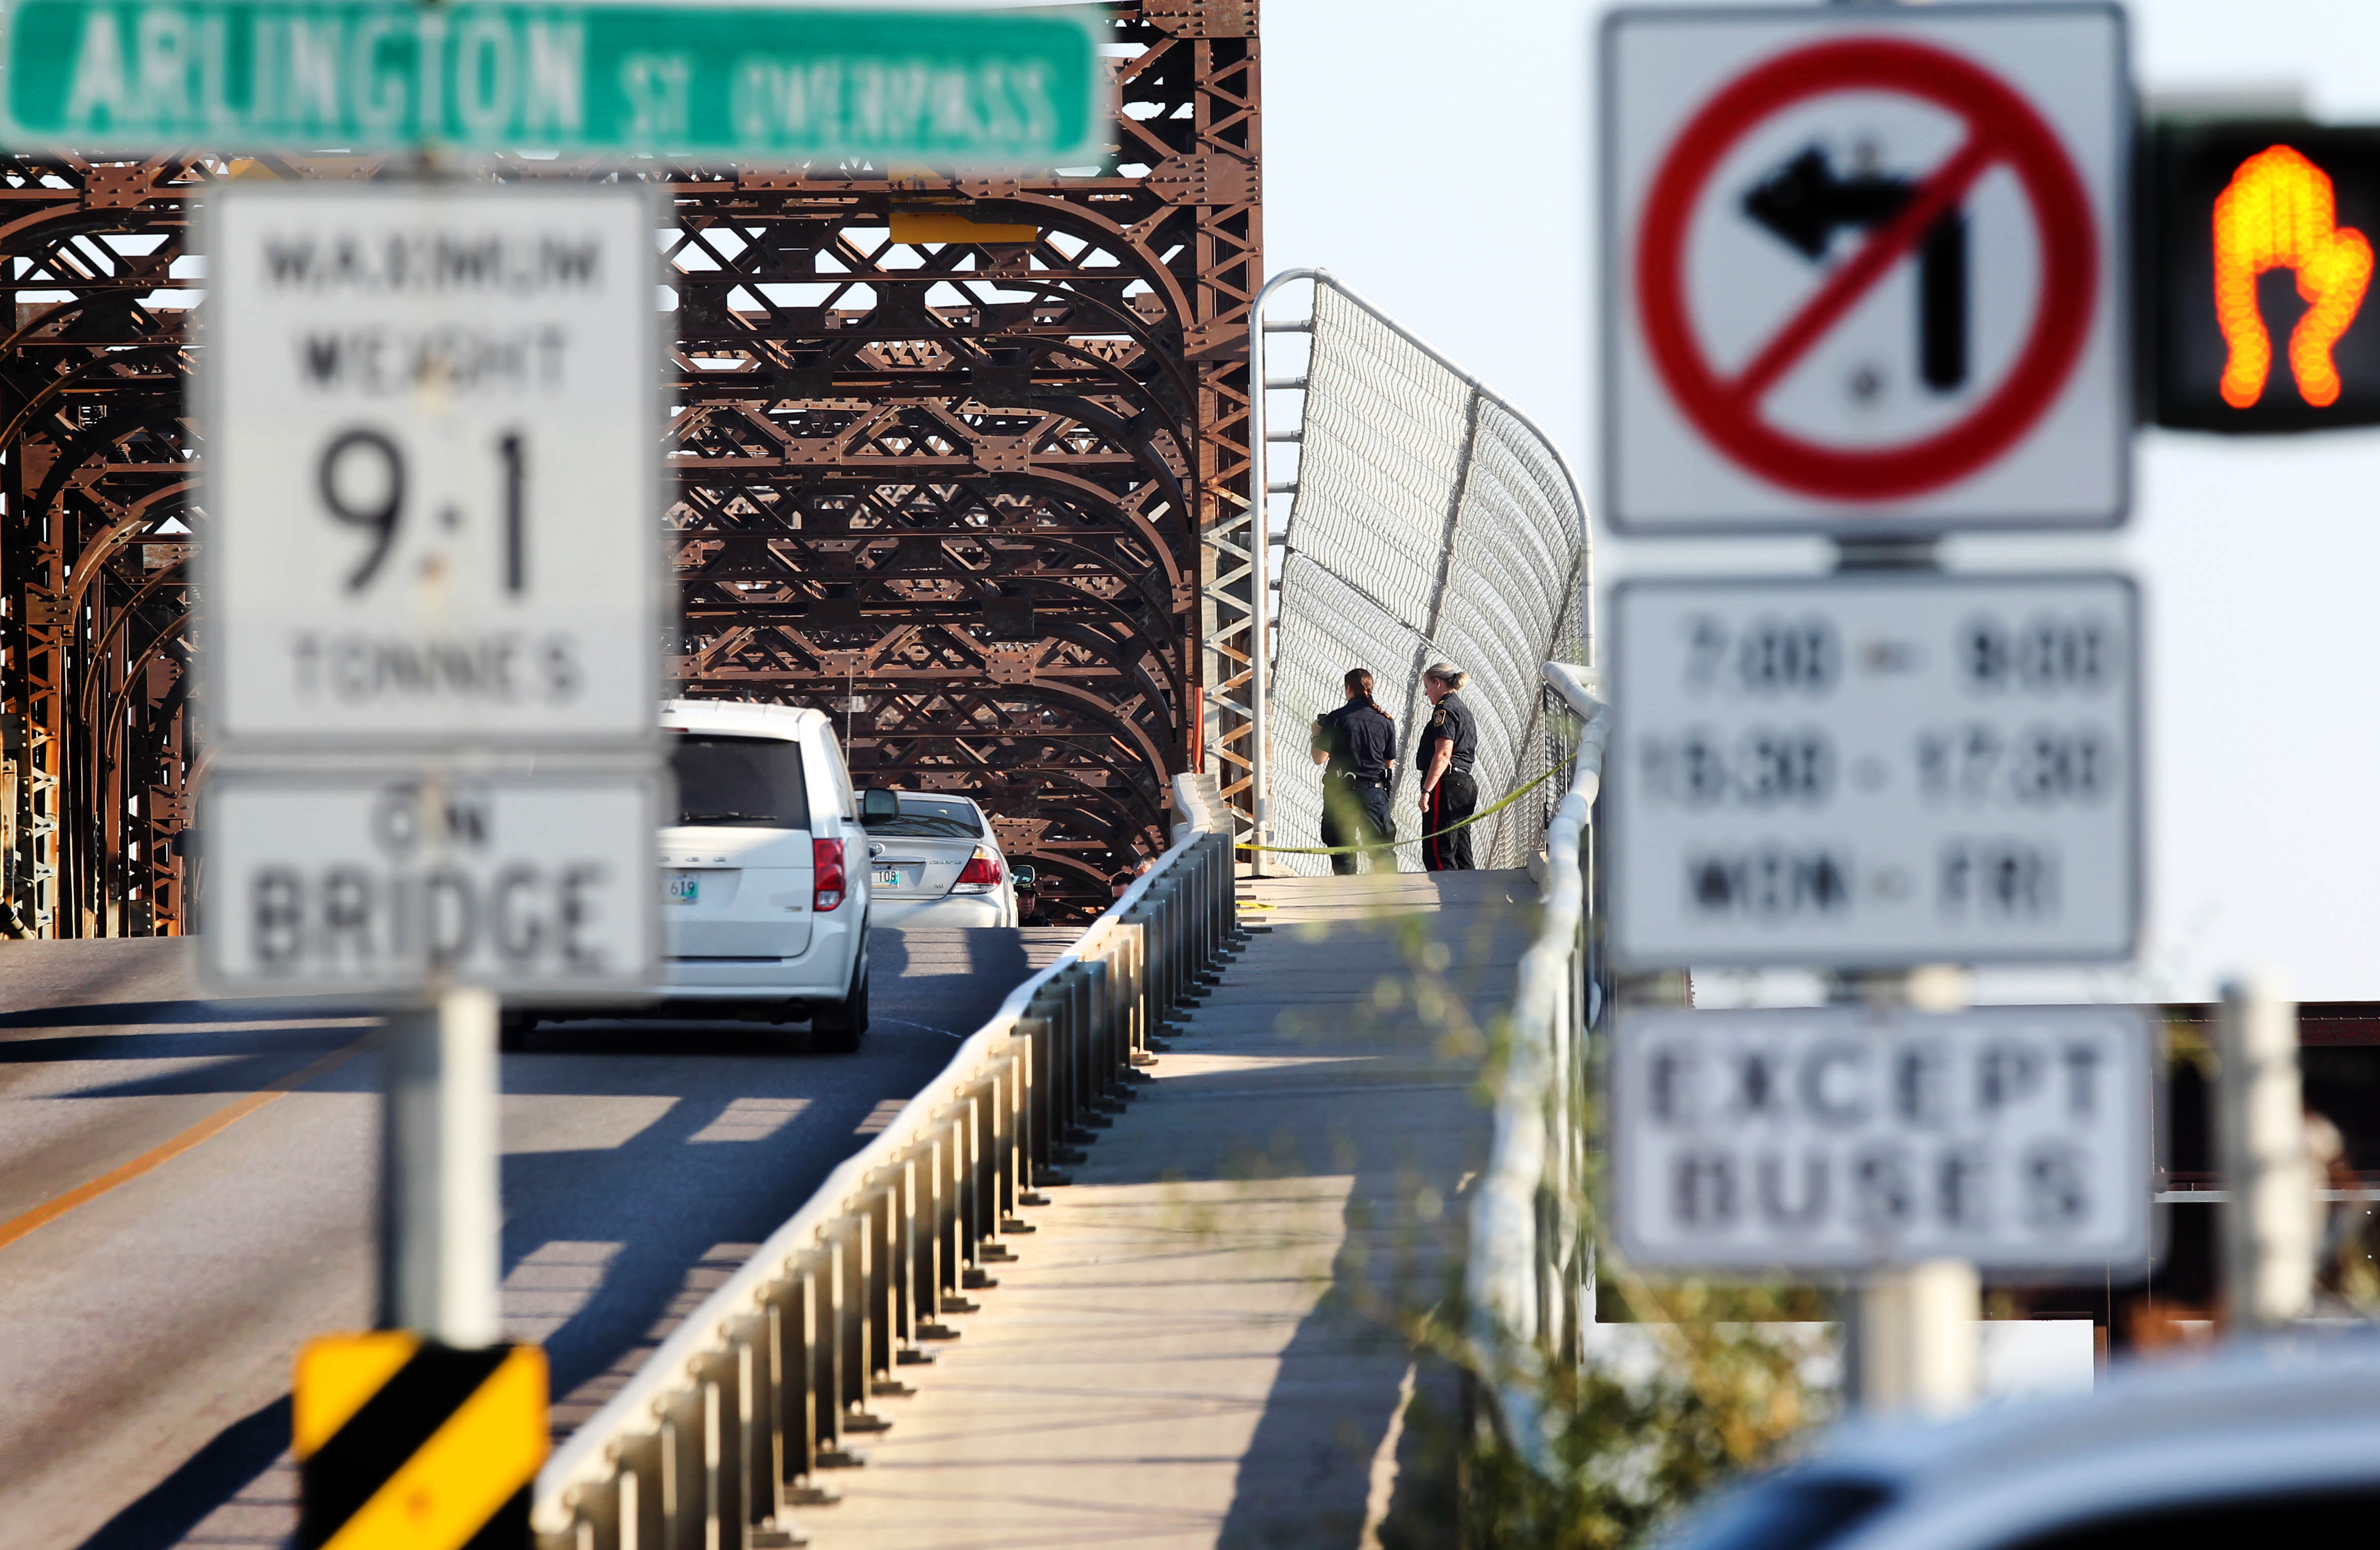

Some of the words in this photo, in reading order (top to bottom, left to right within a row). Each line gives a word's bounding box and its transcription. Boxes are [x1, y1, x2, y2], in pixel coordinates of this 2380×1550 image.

[67, 9, 583, 133] ARLINGTON
[730, 58, 1059, 147] OVERPASS
[262, 231, 605, 292] MAXIMUM
[290, 325, 568, 391] WEIGHT
[289, 629, 587, 708] TONNES
[250, 861, 614, 970] BRIDGE
[670, 881, 695, 896] 619
[1645, 1037, 2108, 1132] EXCEPT
[1668, 1134, 2093, 1230] BUSES
